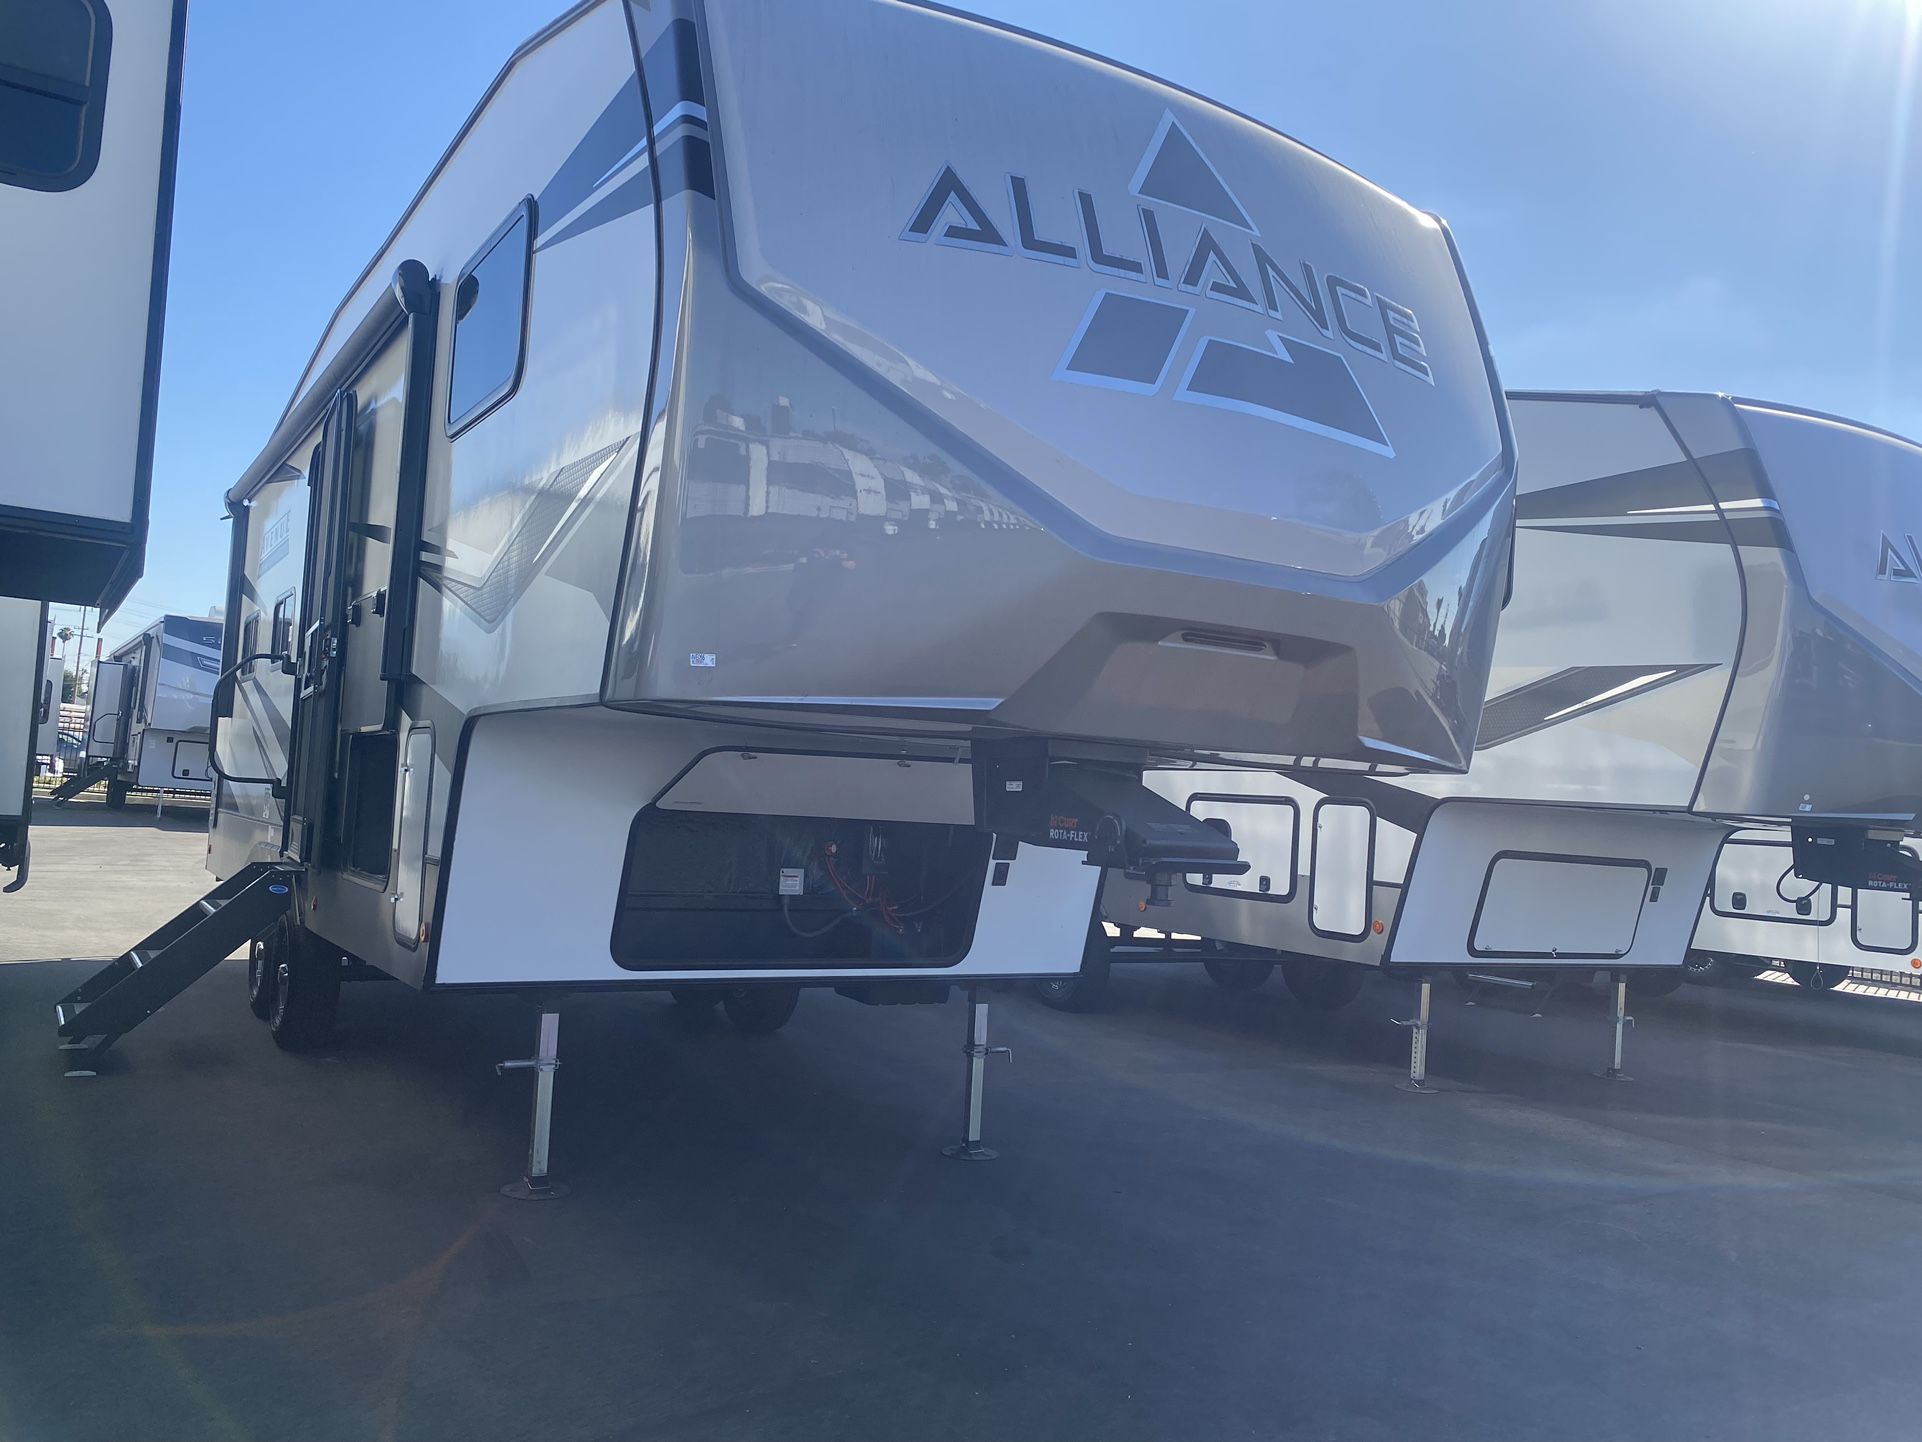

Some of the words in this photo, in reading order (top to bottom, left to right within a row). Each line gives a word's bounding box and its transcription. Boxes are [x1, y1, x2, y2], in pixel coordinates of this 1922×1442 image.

[899, 160, 1435, 387] ALLIANCE
[1050, 828, 1089, 843] ROTA-FLEX
[1868, 880, 1908, 890] ROTA-FLEX
